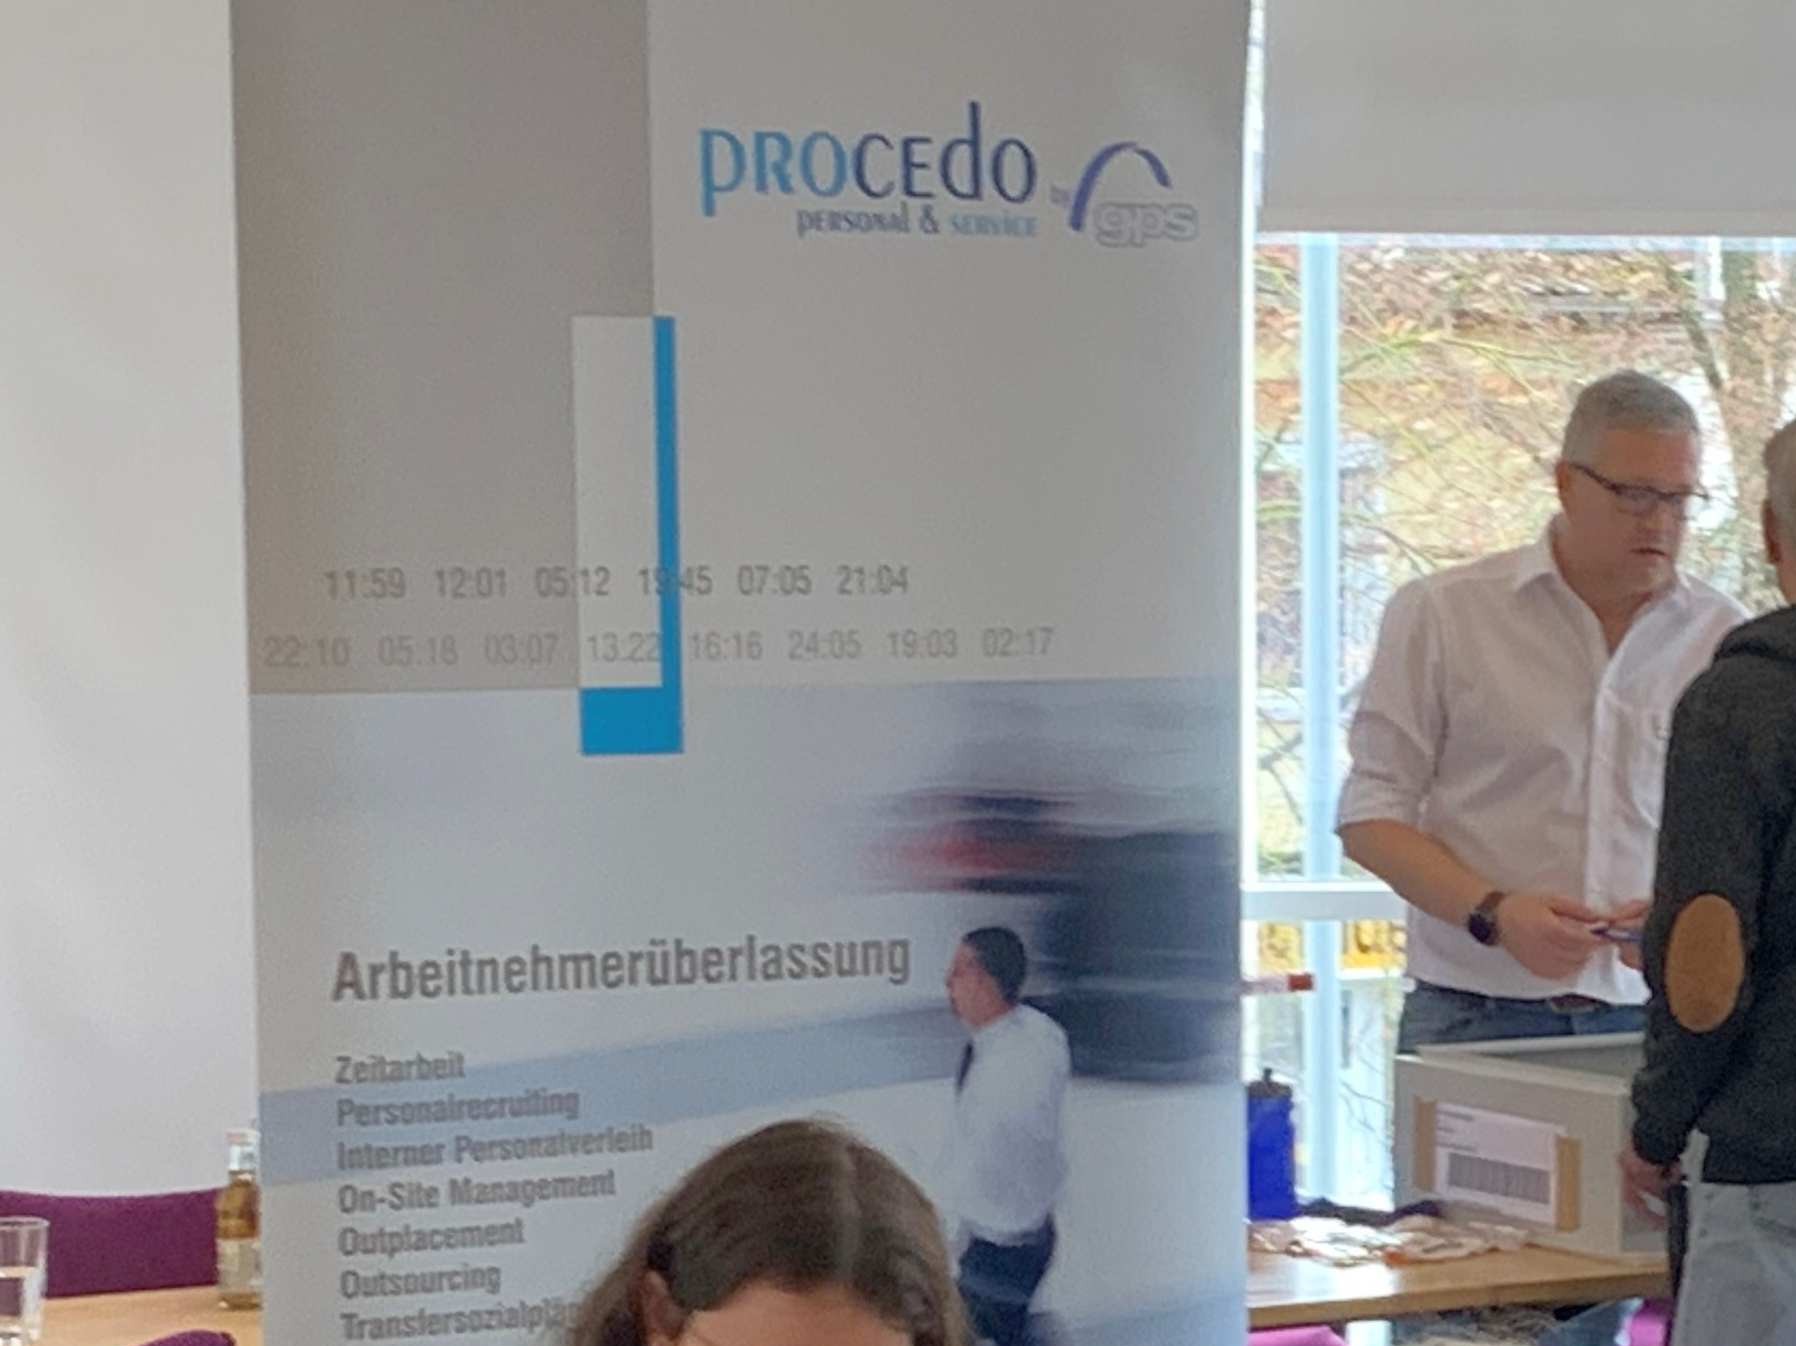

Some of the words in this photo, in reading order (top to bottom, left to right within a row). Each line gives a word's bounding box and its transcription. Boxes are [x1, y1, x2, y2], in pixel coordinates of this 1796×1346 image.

[918, 205, 939, 233] &
[325, 567, 406, 599] 11:59
[436, 566, 507, 597] 12:01
[535, 565, 612, 597] 05:12
[639, 566, 713, 596] 1945
[737, 565, 812, 595] 07:05
[837, 564, 910, 595] 21:04
[263, 635, 350, 668] 22:10
[483, 633, 560, 665] 03:07
[689, 631, 764, 662] 16:16
[788, 629, 862, 660] 24:05
[887, 628, 959, 658] 19:03
[982, 626, 1054, 657] 02:17
[332, 934, 912, 1001] Arbeitnehmerüberlassung
[335, 1050, 466, 1084] Zeitarbeit
[337, 1088, 580, 1127] Personalrecruiting
[337, 1138, 446, 1169] Interner
[453, 1122, 654, 1164] Personalverleih
[338, 1180, 440, 1214] On-Site
[449, 1168, 616, 1208] Management
[338, 1216, 525, 1258] Outplacement
[340, 1264, 501, 1299] Outsourcing
